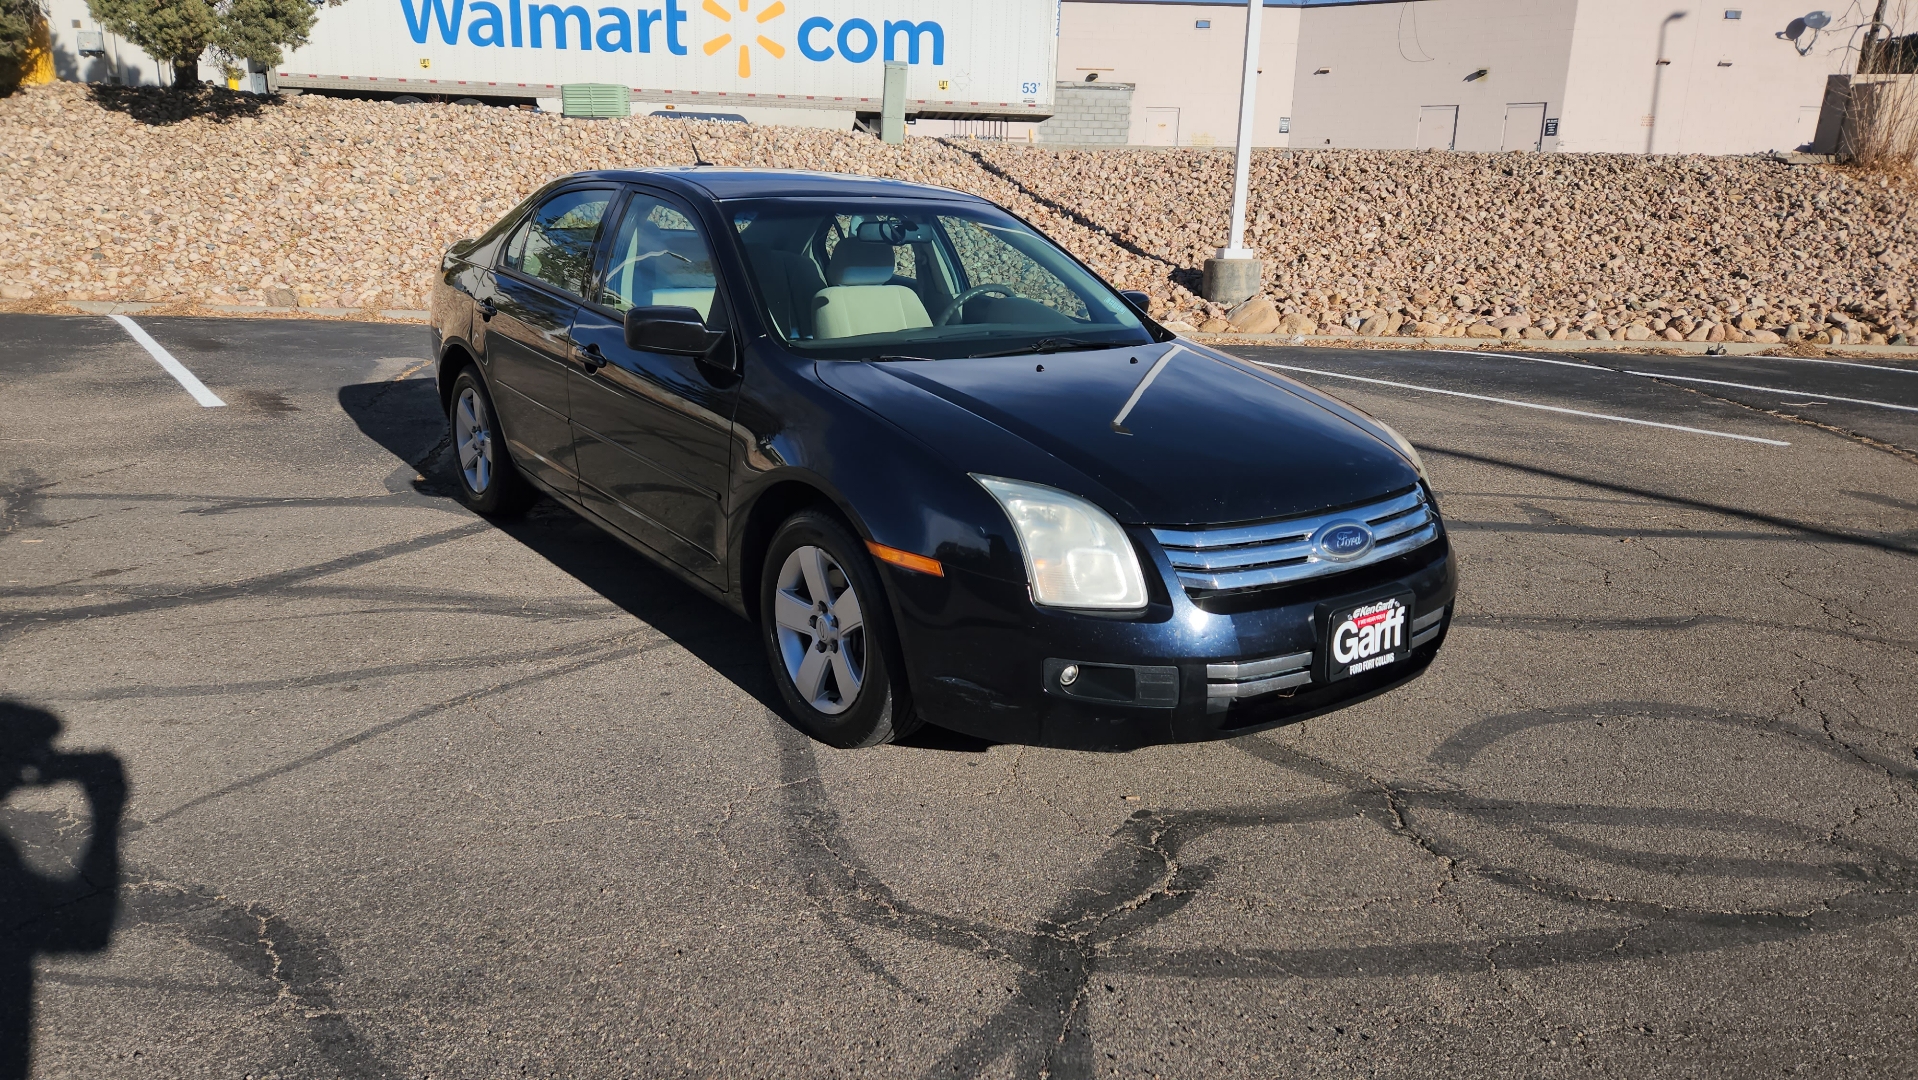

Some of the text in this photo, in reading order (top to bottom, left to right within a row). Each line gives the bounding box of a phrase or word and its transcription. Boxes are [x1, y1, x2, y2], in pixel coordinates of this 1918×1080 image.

[403, 0, 945, 66] Walmart com
[1337, 530, 1363, 549] Ford
[1376, 598, 1395, 613] Garff
[1333, 606, 1406, 664] Garff
[1349, 652, 1395, 676] FORD FORT COLLINS
